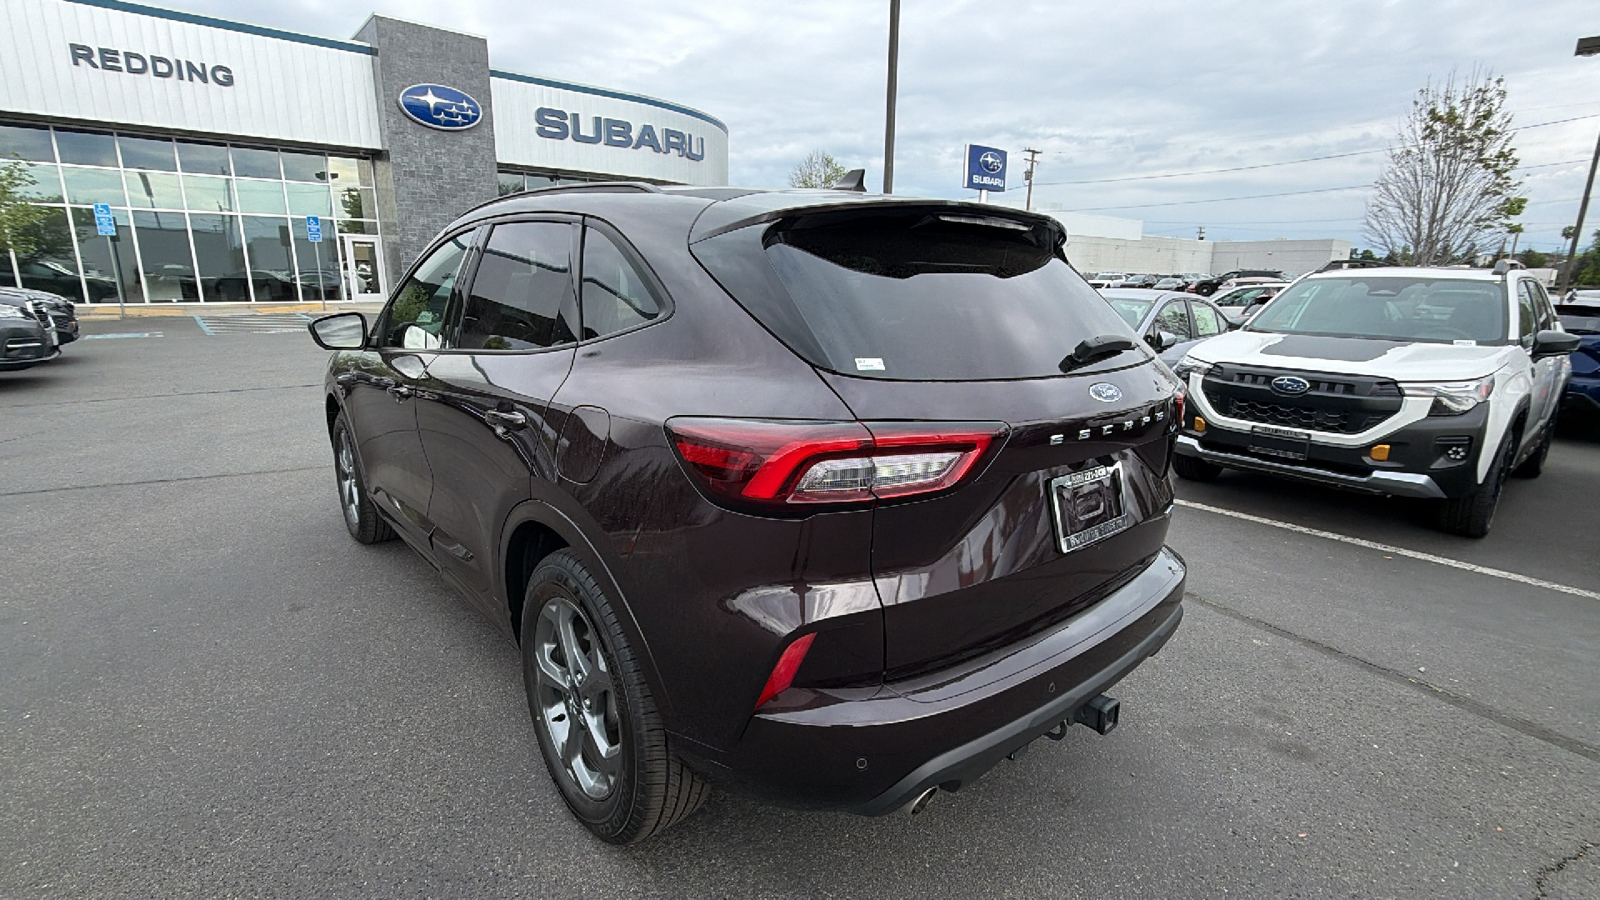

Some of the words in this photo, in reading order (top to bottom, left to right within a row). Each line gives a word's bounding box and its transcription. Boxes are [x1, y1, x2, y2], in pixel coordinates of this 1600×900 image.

[69, 43, 235, 87] REDDING
[535, 106, 705, 162] SUBARU
[972, 174, 1004, 188] SUBARU
[1049, 411, 1164, 445] ESCAPE
